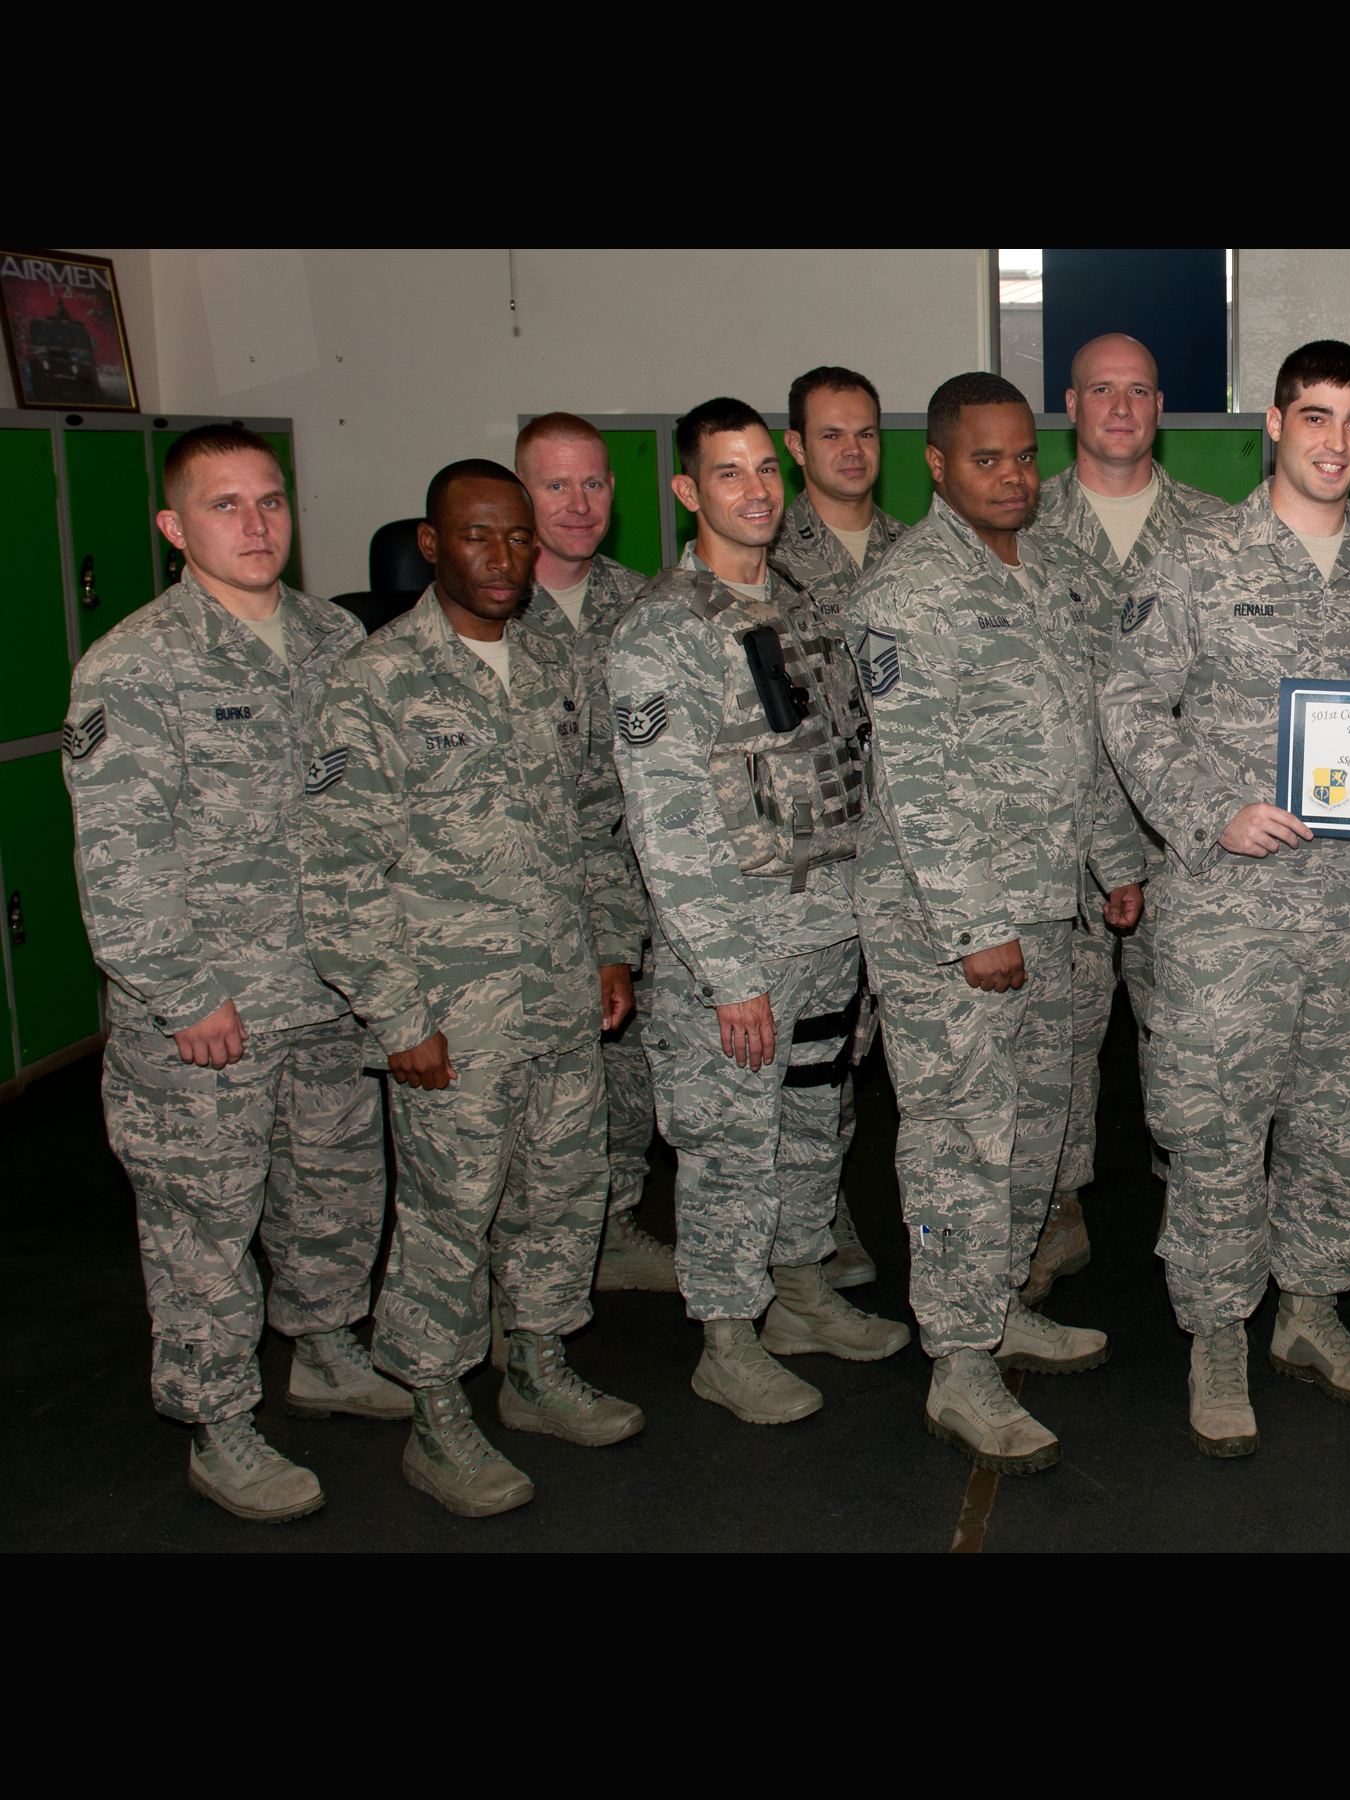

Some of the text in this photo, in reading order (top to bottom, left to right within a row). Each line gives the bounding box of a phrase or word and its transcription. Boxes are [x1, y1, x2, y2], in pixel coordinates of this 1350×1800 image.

[1, 256, 111, 290] AIRMEN
[1233, 604, 1274, 617] RENAUD
[978, 615, 1011, 630] GALLON
[216, 706, 252, 721] BURKS
[1311, 709, 1338, 723] 501st
[425, 733, 467, 751] STACK
